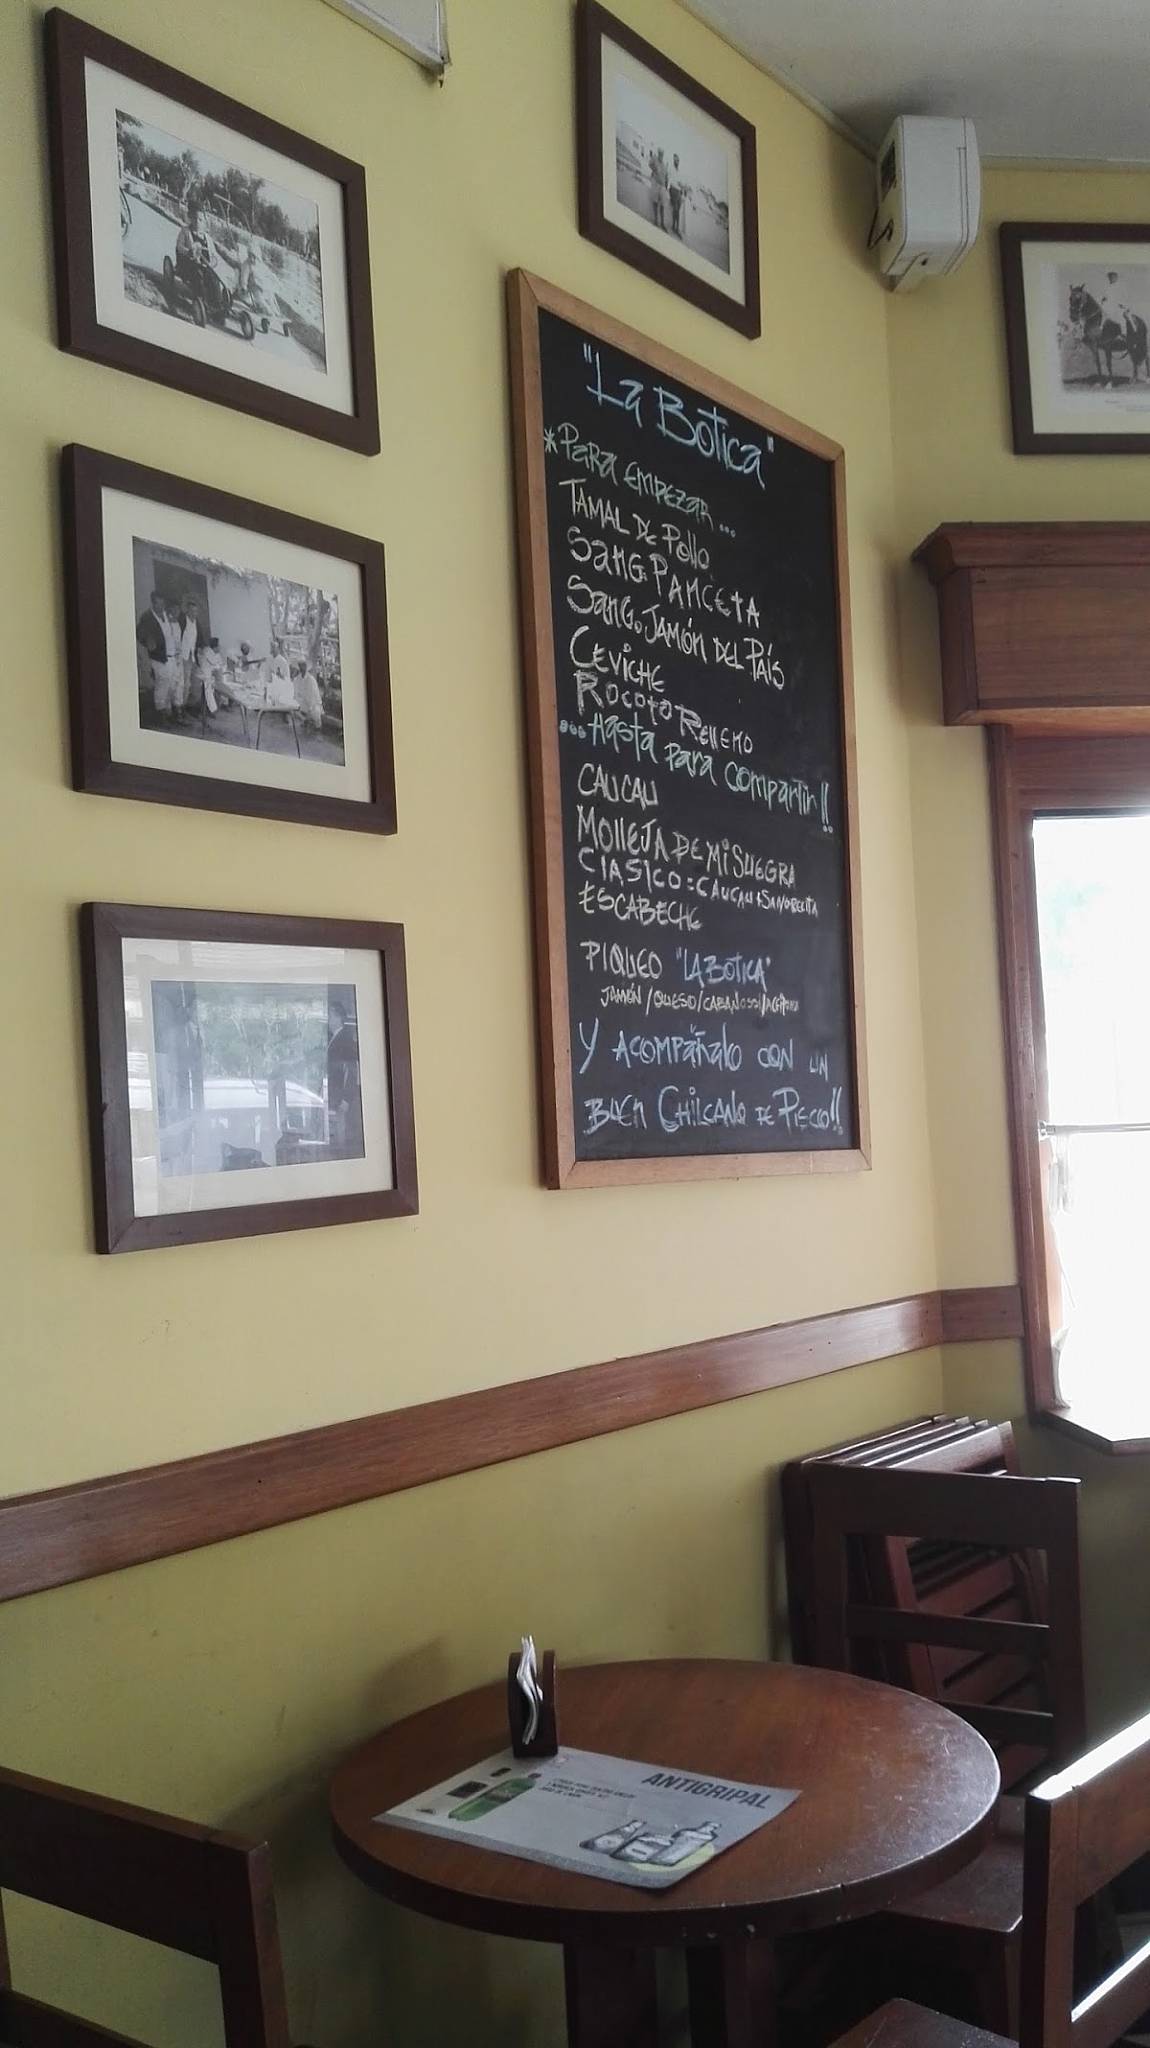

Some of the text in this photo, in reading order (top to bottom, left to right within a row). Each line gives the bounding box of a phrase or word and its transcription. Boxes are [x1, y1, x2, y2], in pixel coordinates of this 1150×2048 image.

[559, 478, 630, 535] TAMAL
[577, 763, 659, 811] CAUCAU
[578, 880, 703, 932] ESCABECHE
[580, 940, 663, 979] PIQUEO
[578, 1018, 599, 1074] Y
[757, 1038, 793, 1071] CON
[809, 1053, 828, 1082] UN
[642, 1772, 771, 1809] ANTIGRIPAL
